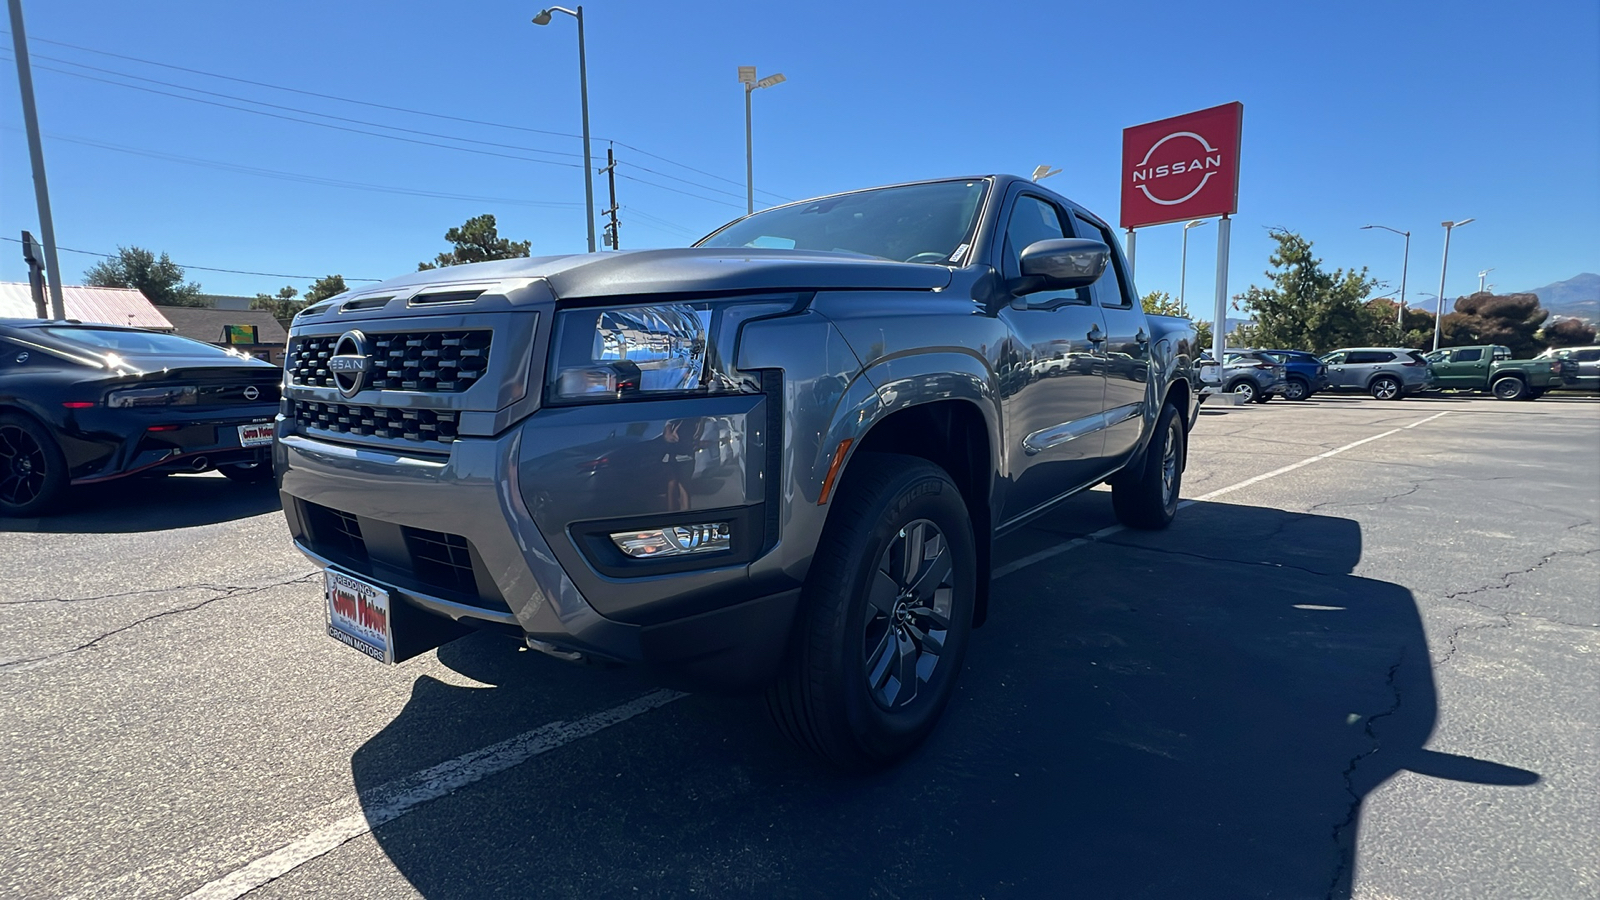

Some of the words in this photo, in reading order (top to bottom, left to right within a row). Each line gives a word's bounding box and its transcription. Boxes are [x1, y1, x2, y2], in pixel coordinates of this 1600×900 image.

[1133, 154, 1221, 182] NISSAN
[329, 627, 353, 646] CROWN
[354, 639, 384, 661] MOTORS
